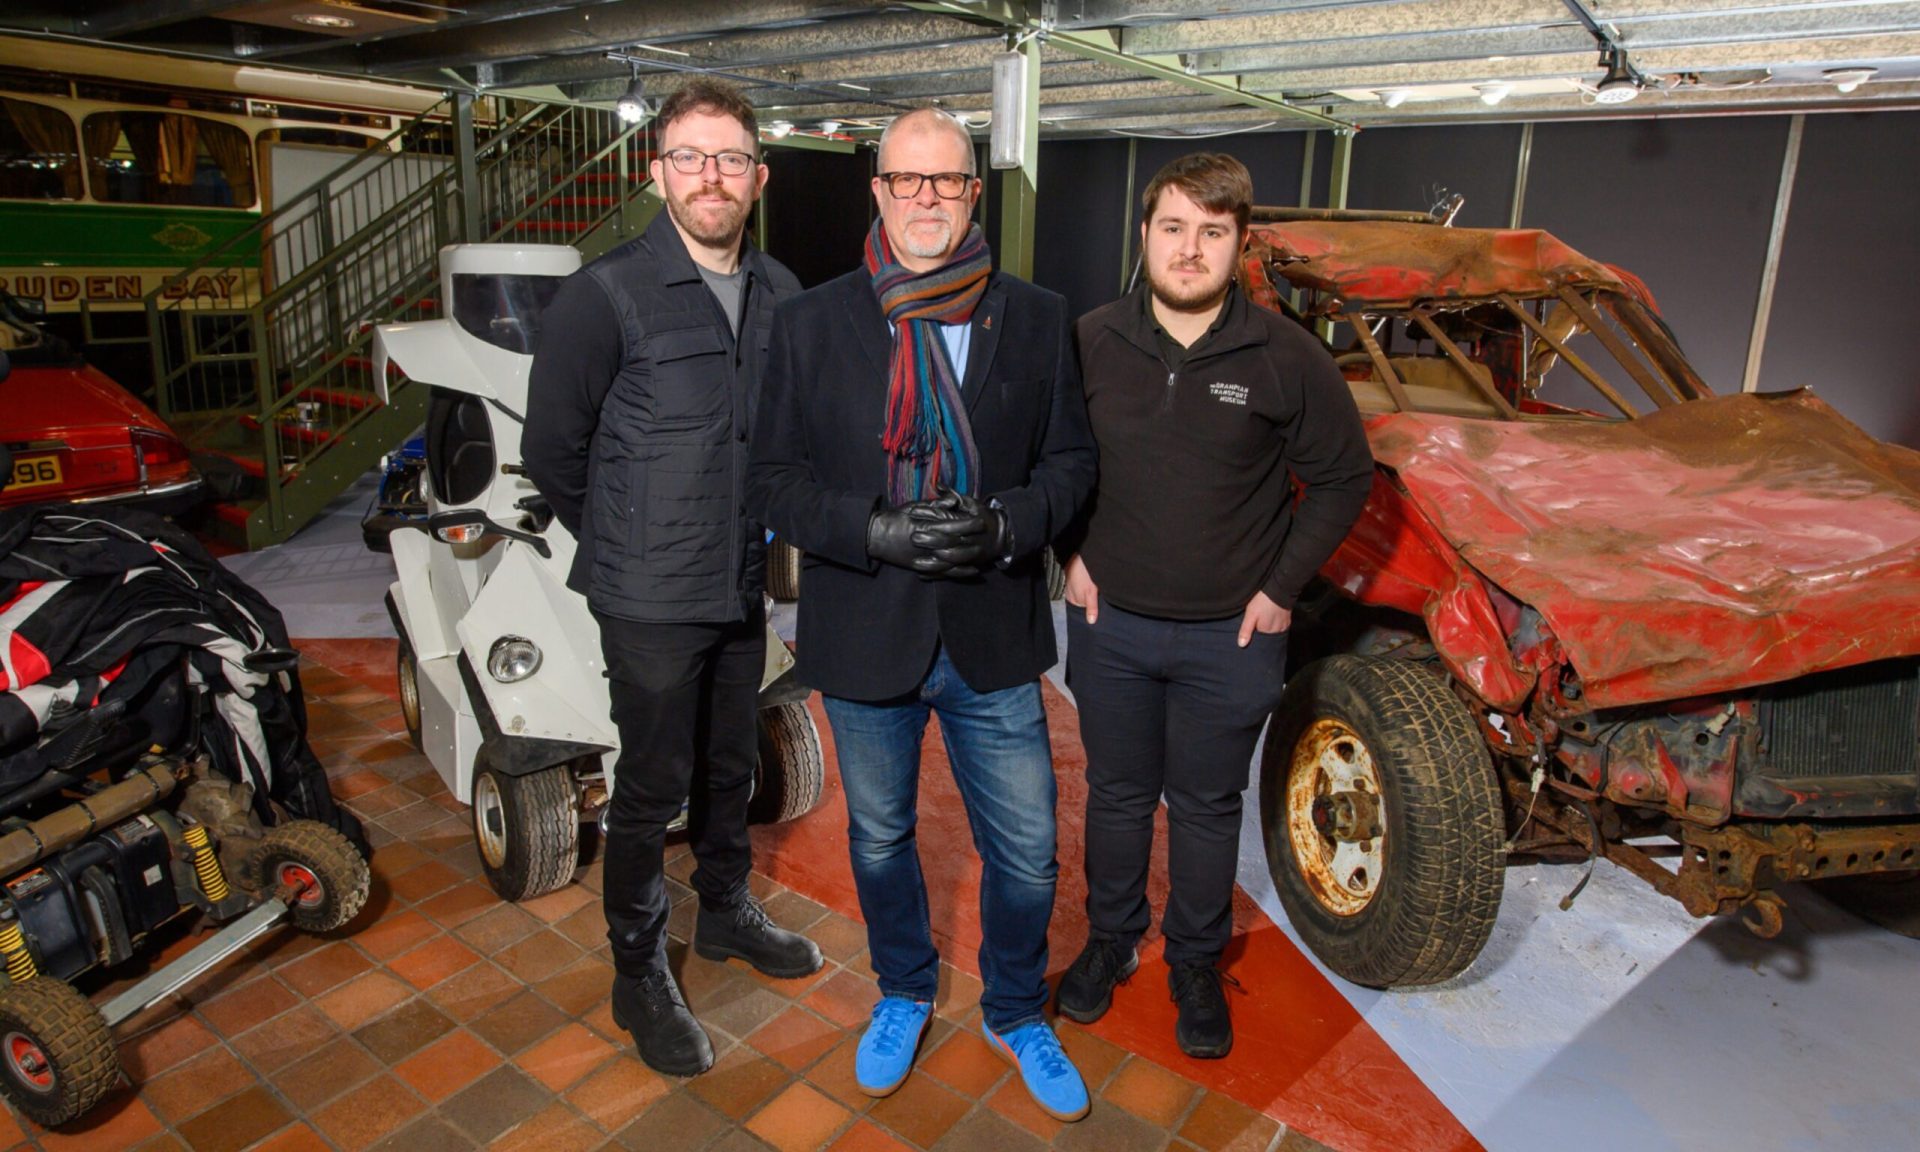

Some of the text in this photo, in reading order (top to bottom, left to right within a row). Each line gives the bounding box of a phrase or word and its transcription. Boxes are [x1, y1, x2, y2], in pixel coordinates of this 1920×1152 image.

[162, 275, 238, 300] BAY
[1219, 396, 1246, 405] MUSEUM
[9, 461, 56, 484] 96
